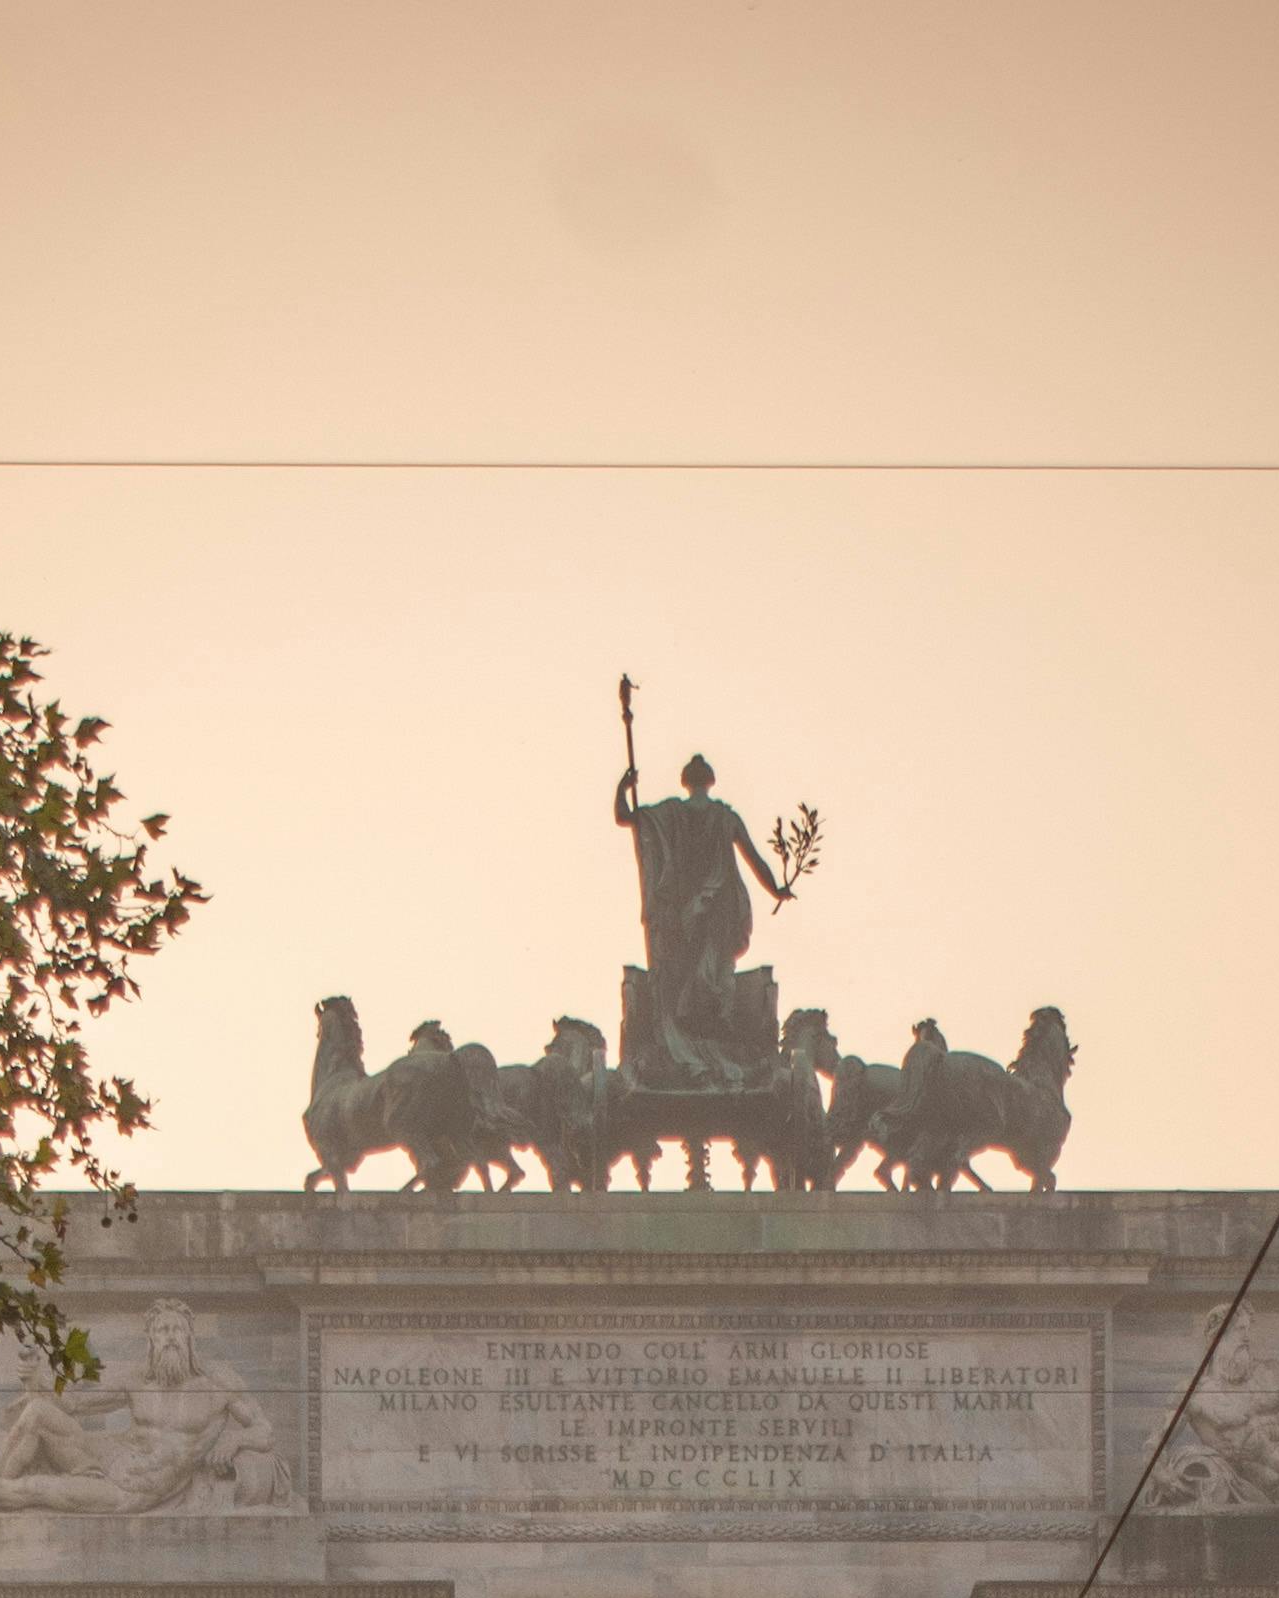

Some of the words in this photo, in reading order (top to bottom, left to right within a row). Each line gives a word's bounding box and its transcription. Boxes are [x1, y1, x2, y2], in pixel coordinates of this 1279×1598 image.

[486, 1342, 622, 1361] ENTRANDO
[728, 1342, 789, 1361] ARMI
[810, 1341, 930, 1361] GLORIOSE
[333, 1367, 484, 1387] NAPOLEONE
[504, 1367, 530, 1387] III
[551, 1368, 565, 1387] E
[586, 1367, 709, 1387] VITTORIO
[727, 1367, 865, 1387] EMANUELE
[885, 1367, 903, 1387] II
[923, 1367, 1079, 1387] LIBERATORI
[378, 1393, 478, 1413] MILANO
[498, 1393, 635, 1413] ESULTANTE
[797, 1393, 829, 1413] DA
[848, 1393, 935, 1414] QUESTI
[951, 1392, 1036, 1412] MARMI
[559, 1419, 585, 1438] LE
[607, 1419, 737, 1438] IMPRONTE
[758, 1419, 855, 1438] SERVILI
[417, 1445, 431, 1464] E
[455, 1445, 480, 1464] VI
[501, 1444, 598, 1464] SCRISSE
[651, 1444, 847, 1464] INDIPENDENZA
[907, 1444, 994, 1463] ITALIA
[611, 1470, 803, 1489] MDCCCLIX
